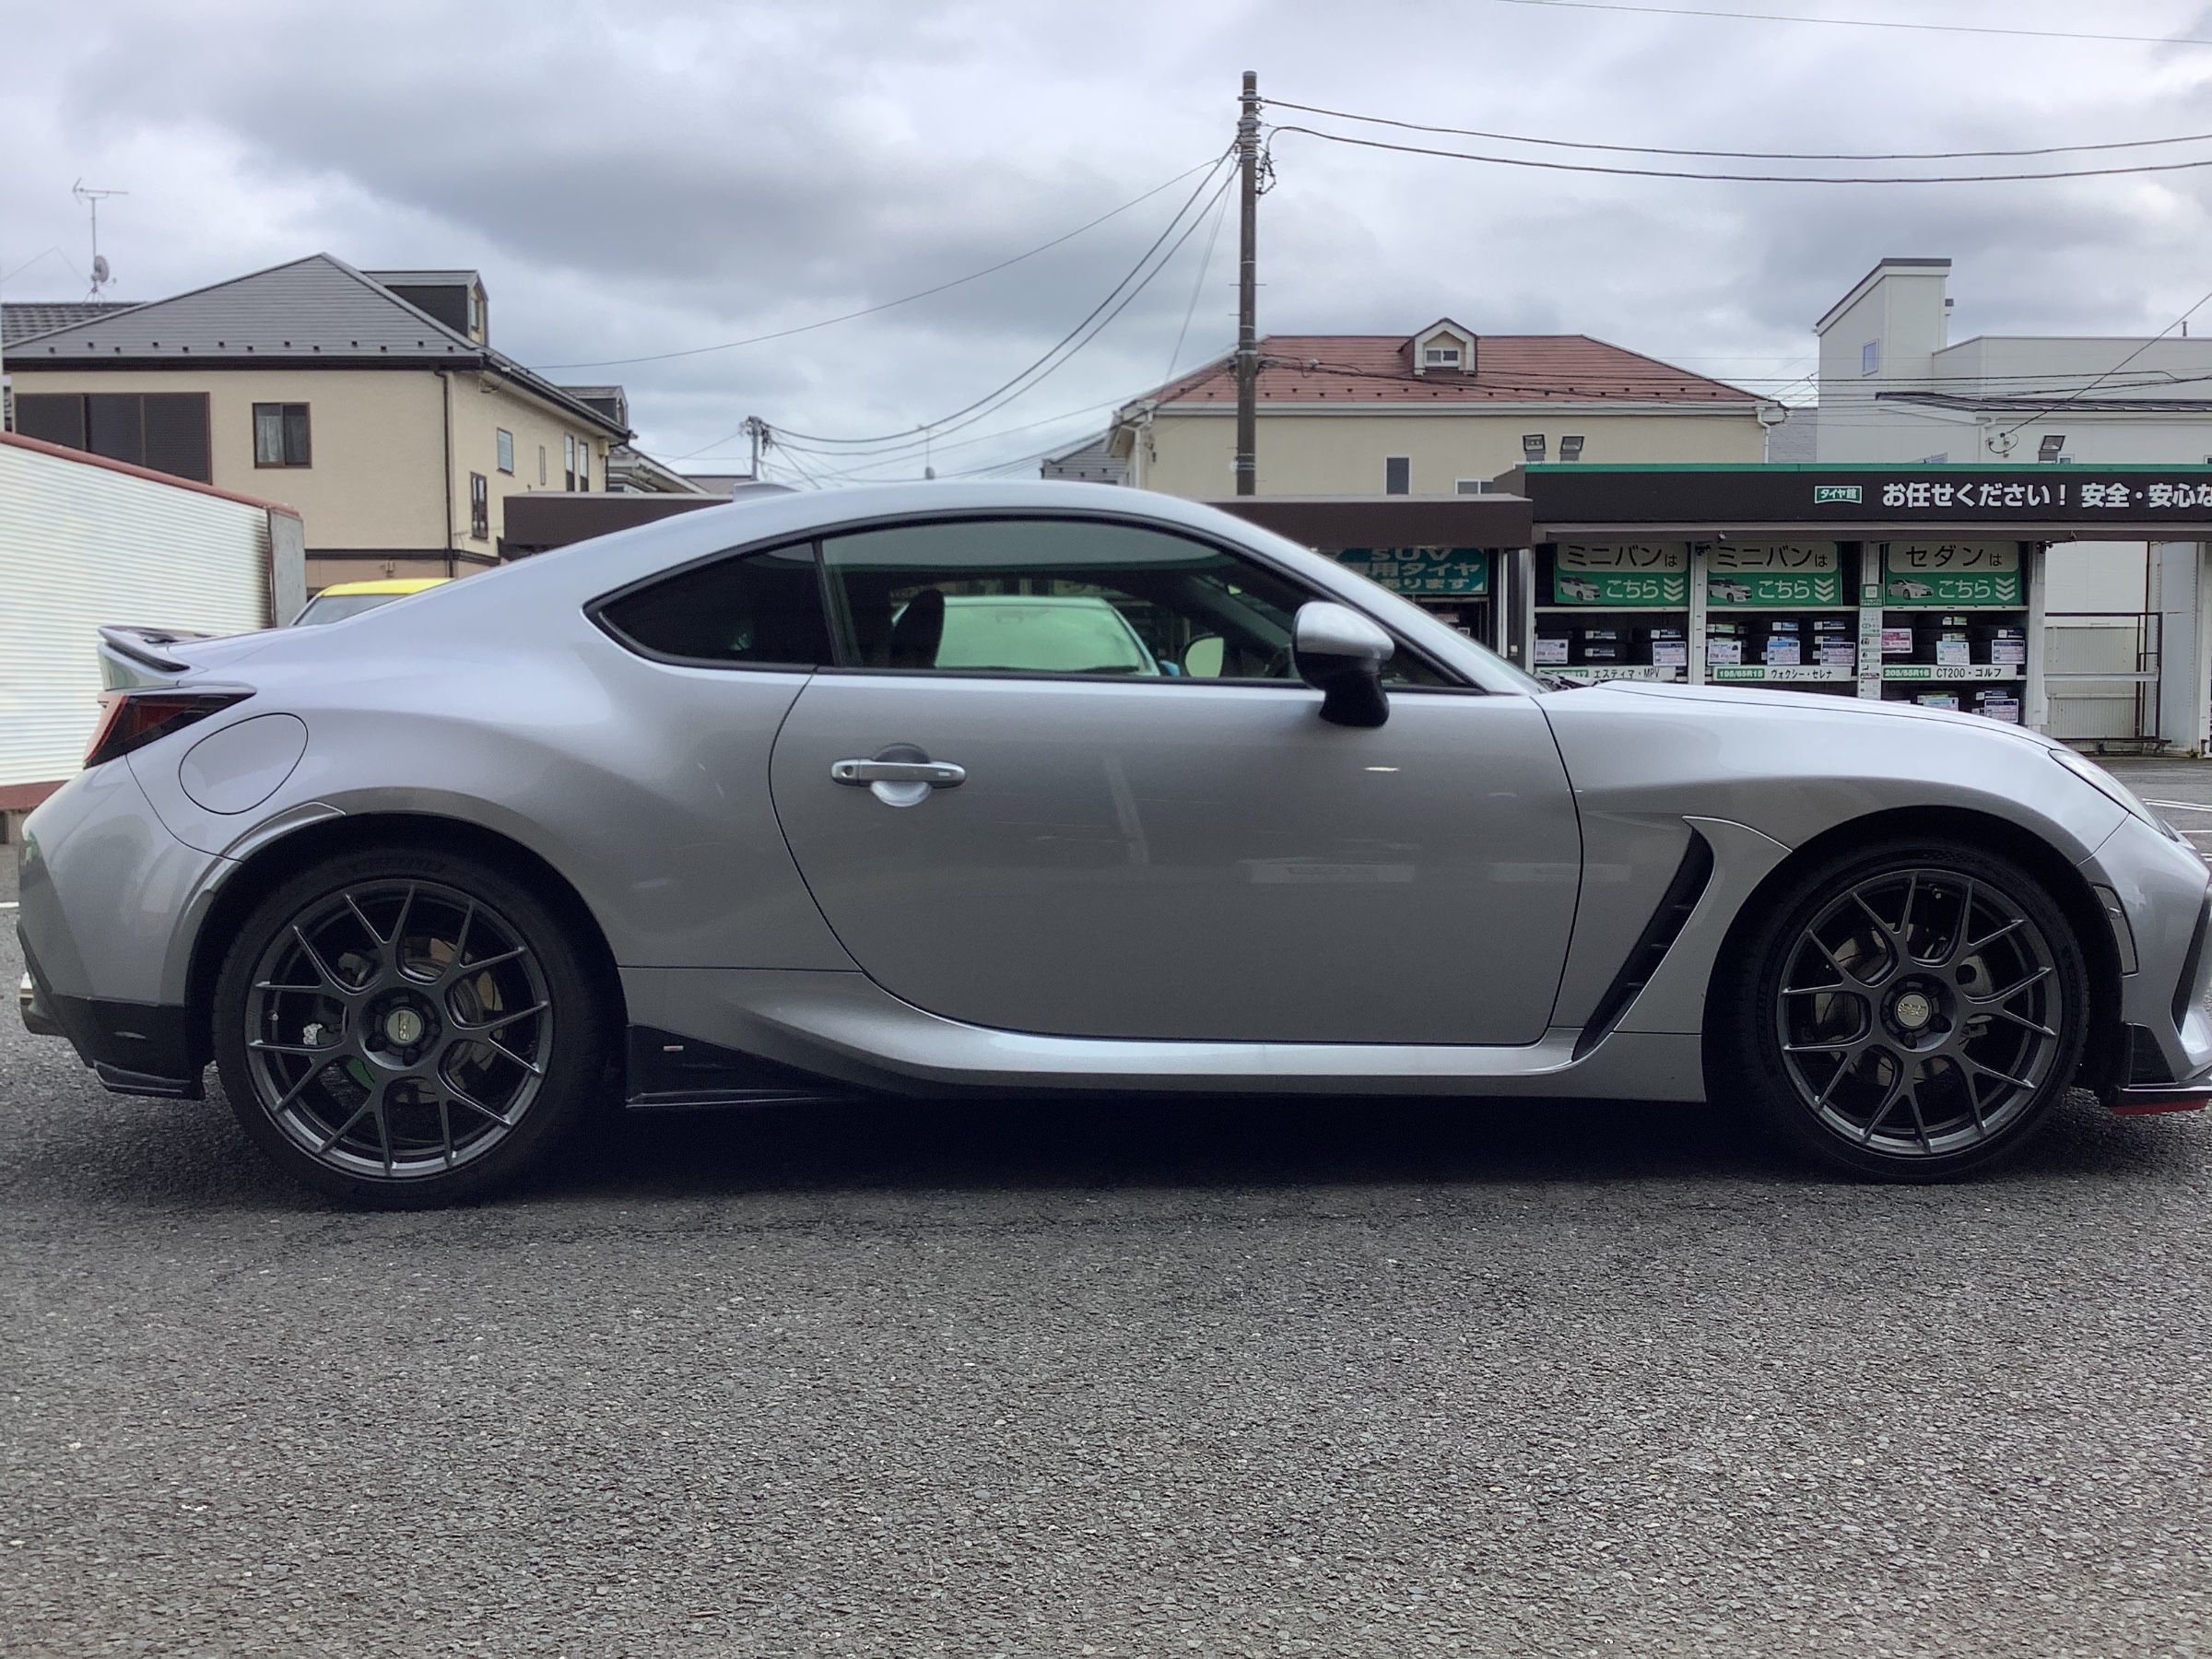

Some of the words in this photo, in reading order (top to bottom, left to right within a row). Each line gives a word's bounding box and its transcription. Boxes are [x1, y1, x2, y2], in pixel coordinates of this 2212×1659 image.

[1820, 488, 1857, 500] タイヤ館
[1882, 482, 2066, 508] お任せください！
[2081, 482, 2212, 508] 安全・安心な
[1567, 545, 1677, 567] ミニバンは
[1717, 545, 1828, 568] ミニバンは
[1905, 545, 2002, 568] セダンは
[1606, 580, 1659, 599] こちら
[1758, 580, 1810, 599] こちら
[1938, 580, 1991, 599] こちら
[1594, 668, 1660, 679] エスティマ・MPV
[1771, 669, 1832, 679] ヴォクシー・セレナ
[1936, 667, 2002, 678] CT200・ゴルフ
